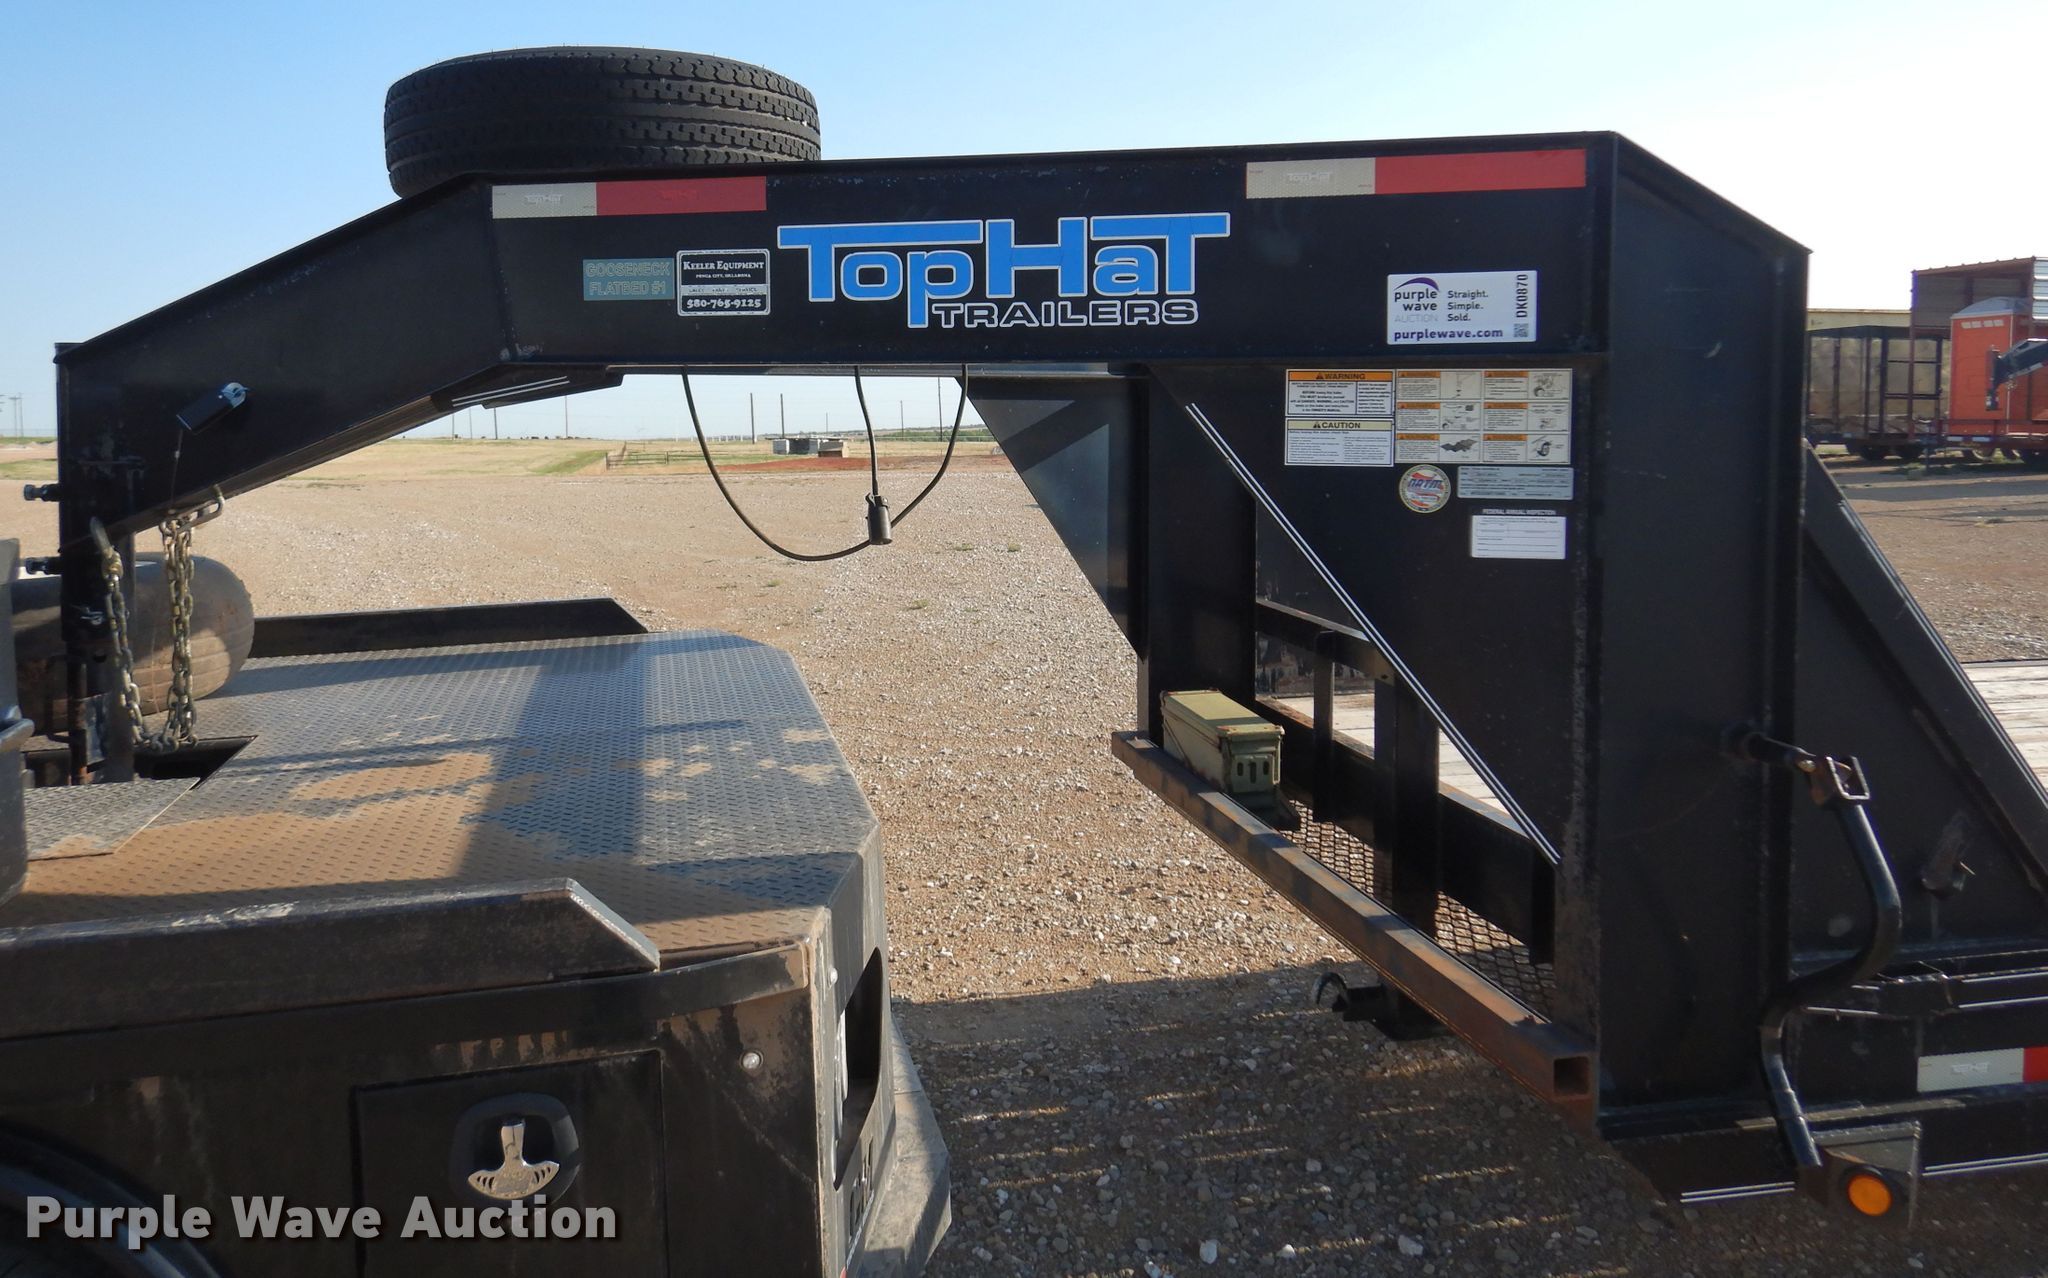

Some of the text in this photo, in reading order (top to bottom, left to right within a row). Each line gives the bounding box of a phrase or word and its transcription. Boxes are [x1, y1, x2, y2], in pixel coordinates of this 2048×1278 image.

[585, 262, 671, 277] GOOSENECK
[683, 260, 765, 271] KEELER EQUIPMENT
[589, 281, 649, 296] FLATBED
[1394, 288, 1438, 302] purple
[1447, 289, 1489, 300] Straight.
[1516, 274, 1529, 318] DK0870
[686, 298, 762, 309] 580-765-9125
[1402, 302, 1438, 311] wave
[1447, 301, 1484, 311] Simple.
[931, 299, 1200, 328] TRAILERS
[1394, 313, 1439, 323] AUCTION
[1447, 313, 1471, 322] Sold.
[1394, 328, 1503, 342] purplewave.com
